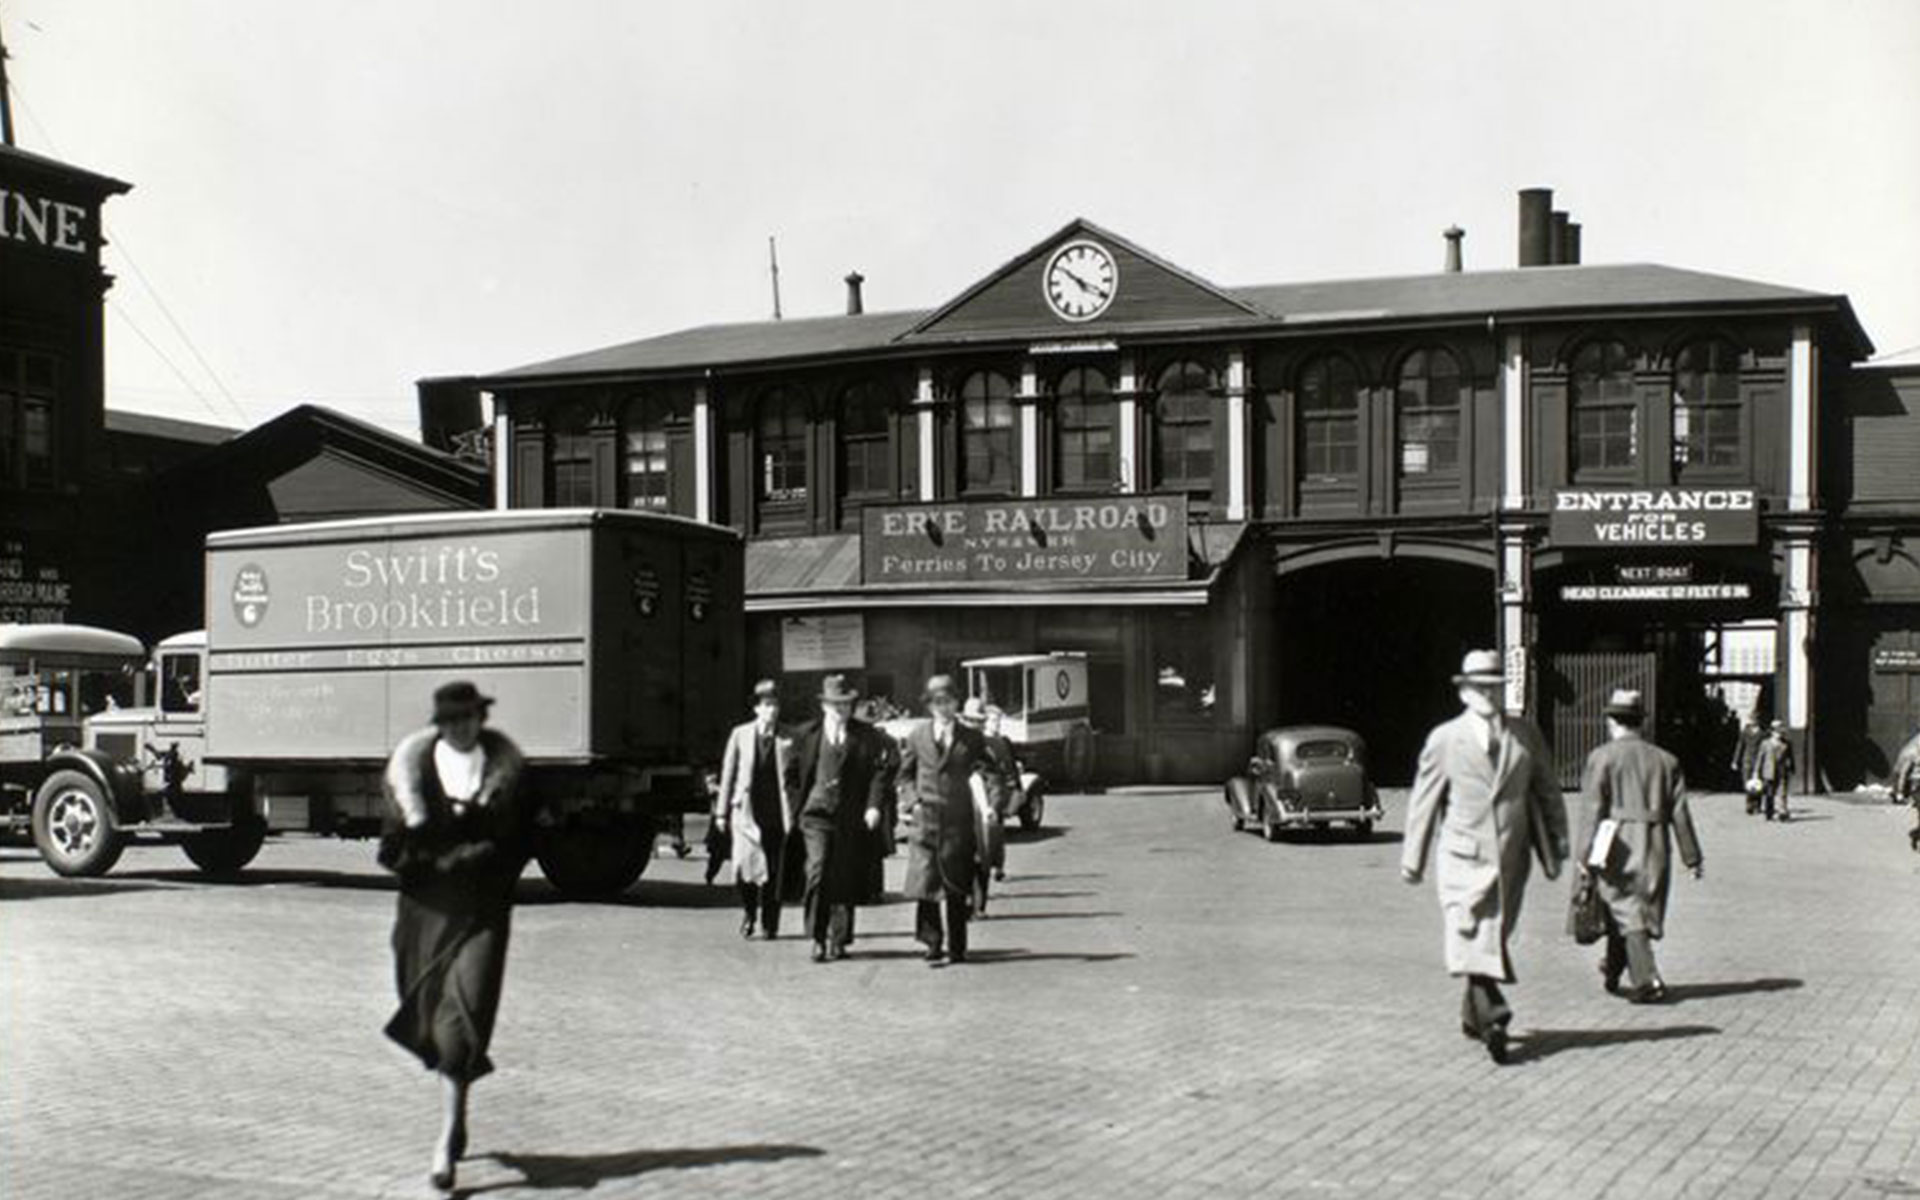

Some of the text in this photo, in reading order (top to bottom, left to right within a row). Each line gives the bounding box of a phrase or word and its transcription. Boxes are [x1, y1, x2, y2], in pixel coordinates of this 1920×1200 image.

[1556, 491, 1754, 511] ENTRANCE
[985, 503, 1169, 534] RAILROAD
[1628, 513, 1676, 522] FOR
[1594, 522, 1706, 541] VEHICLES
[345, 545, 499, 588] Swift's
[882, 547, 1162, 574] Ferries To Jersey City
[1619, 566, 1690, 580] NEXT BOAT
[1562, 585, 1596, 600] HEAD
[1599, 585, 1670, 600] CLEARANCE
[306, 588, 541, 632] Brookfield
[451, 645, 565, 662] Cheese
